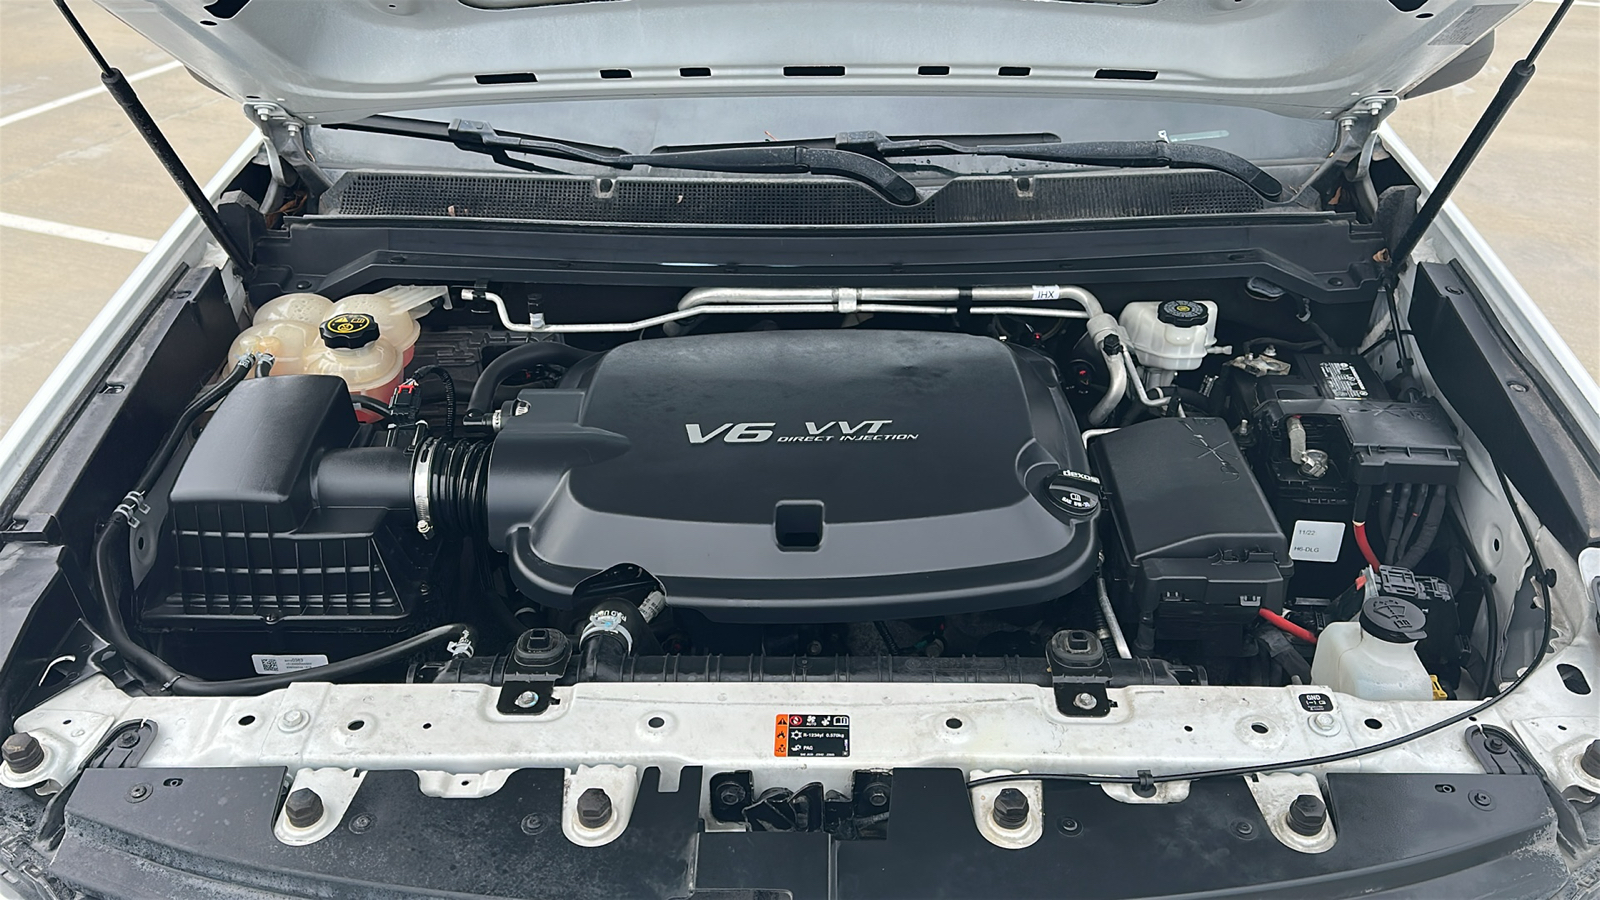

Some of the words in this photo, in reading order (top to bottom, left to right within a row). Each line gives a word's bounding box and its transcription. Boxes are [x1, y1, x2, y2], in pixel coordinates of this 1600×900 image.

[1037, 290, 1055, 299] IHX
[685, 422, 776, 444] V6
[805, 419, 893, 435] VVT
[776, 435, 835, 443] DIRECT
[839, 433, 919, 442] INJECTION
